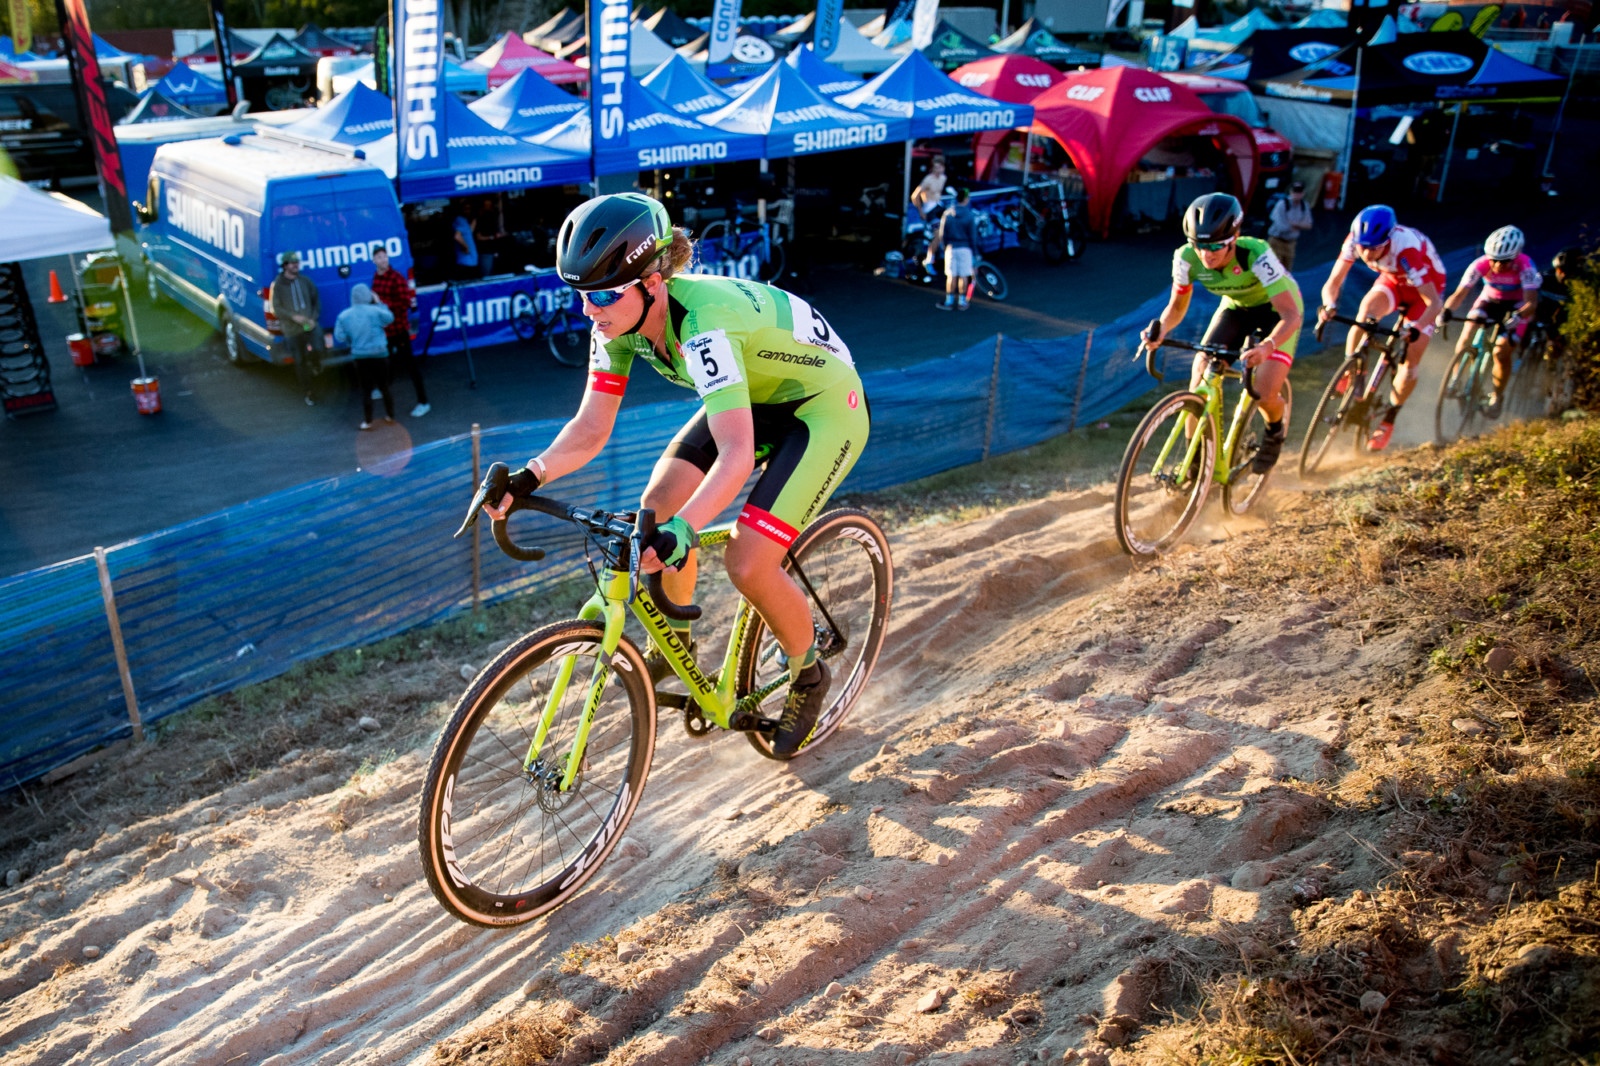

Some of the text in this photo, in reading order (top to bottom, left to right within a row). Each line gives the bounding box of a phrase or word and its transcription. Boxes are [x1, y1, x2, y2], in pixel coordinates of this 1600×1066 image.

[600, 0, 629, 139] SHIM
[1015, 73, 1052, 88] CLIF
[70, 0, 126, 197] KEND
[1066, 84, 1105, 102] CLIF
[1133, 86, 1173, 102] CLIF
[934, 109, 1015, 134] SHIMANO
[793, 122, 888, 153] SHIMANO
[637, 141, 728, 167] SHIMANO
[454, 166, 543, 191] SHIMANO
[166, 187, 245, 259] SHIMANO
[625, 232, 657, 265] GIRO
[563, 271, 580, 281] GIRO
[1262, 261, 1275, 276] 3
[430, 286, 575, 333] SHIMANO
[699, 347, 719, 378] 5
[757, 349, 827, 369] cannondale
[800, 439, 852, 526] cannondale
[755, 518, 793, 542] SRAM
[839, 526, 884, 565] ZIPP
[635, 587, 712, 697] cannondale
[587, 664, 609, 723] SUPER
[559, 782, 633, 891] ZIPP
